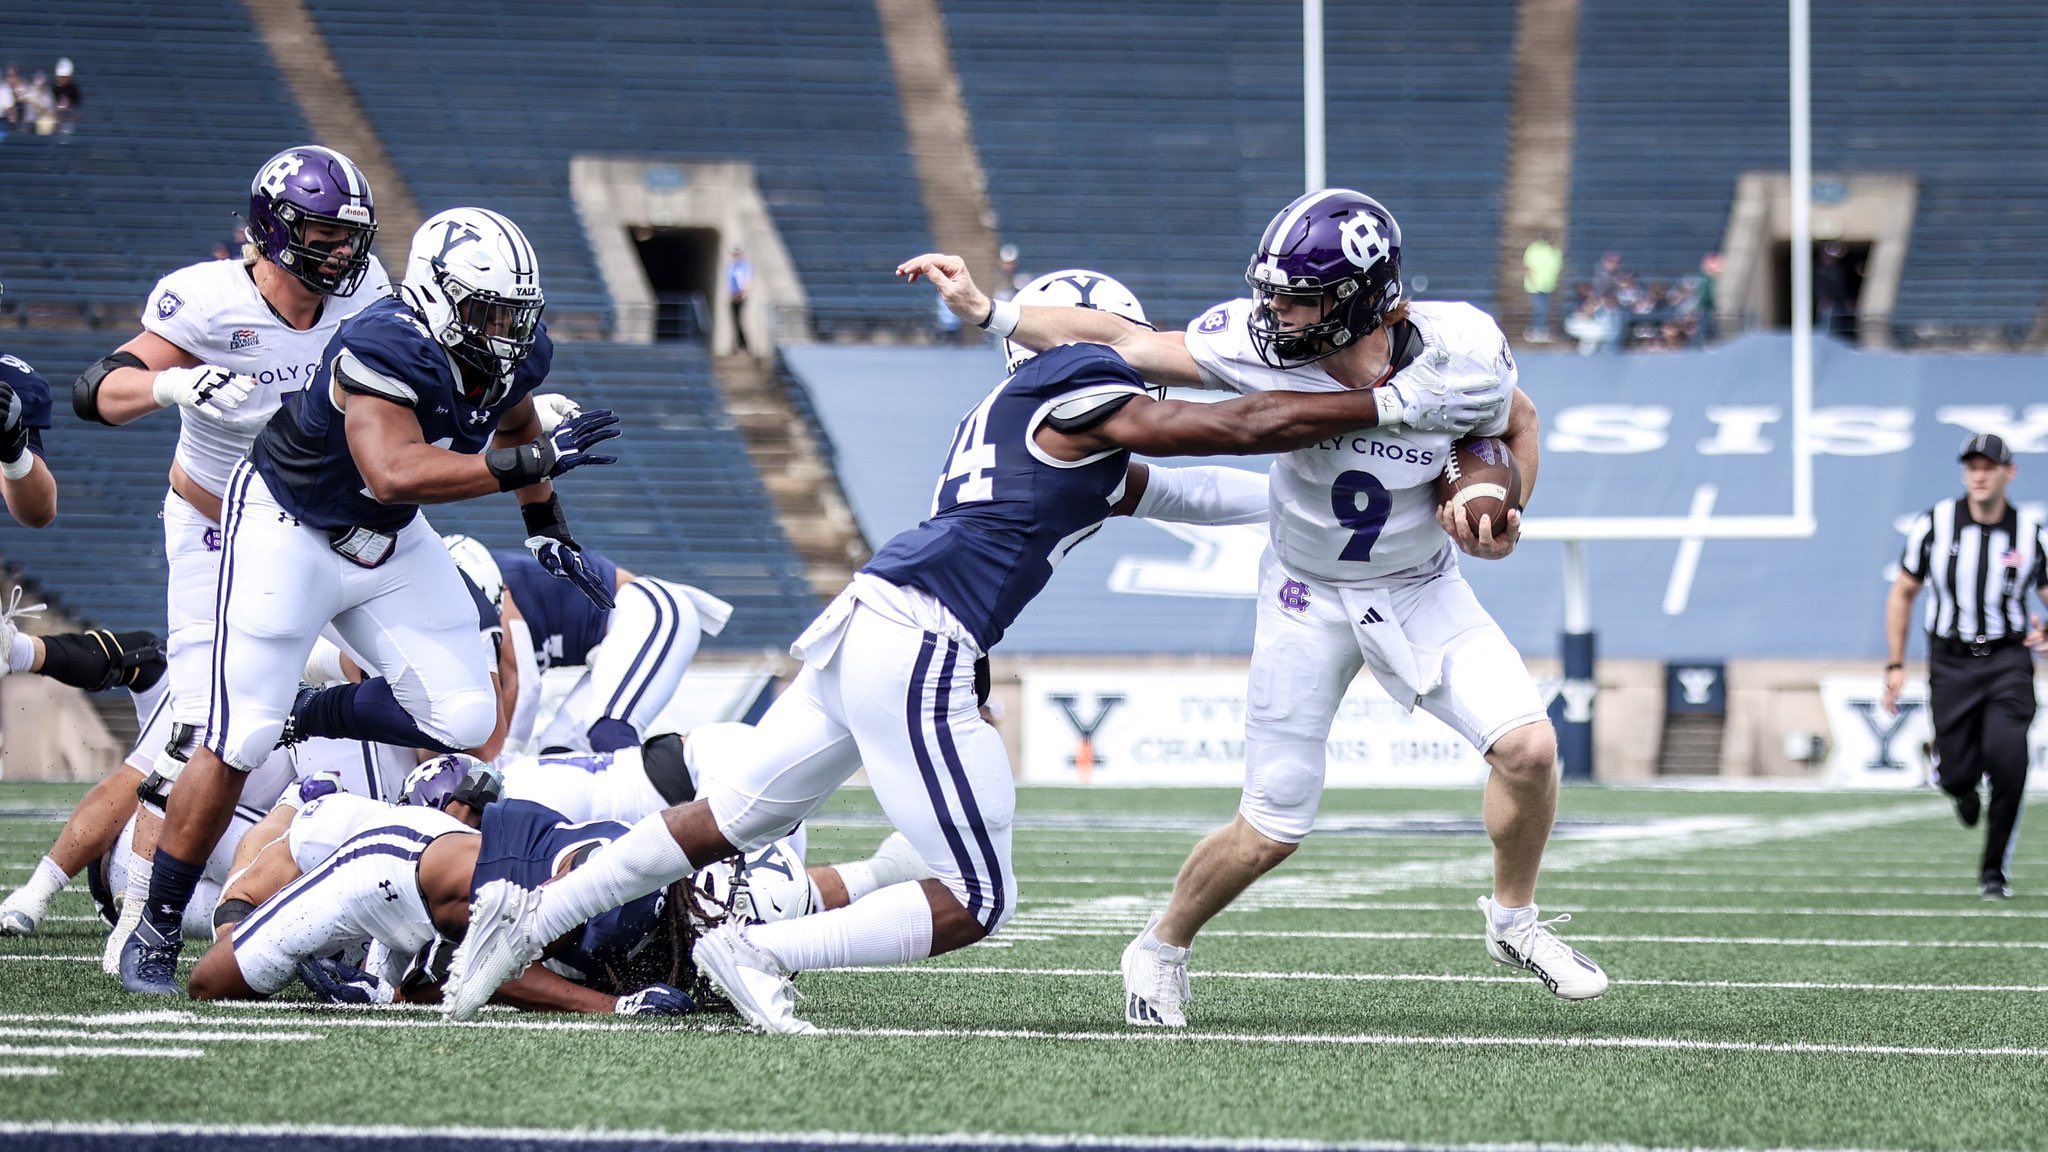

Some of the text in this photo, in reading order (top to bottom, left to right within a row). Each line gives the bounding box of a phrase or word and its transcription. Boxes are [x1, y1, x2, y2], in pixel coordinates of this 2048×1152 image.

[431, 220, 482, 269] Y
[516, 287, 536, 296] YALE
[1054, 275, 1106, 310] Y
[1351, 437, 1434, 466] CROSS
[1331, 469, 1393, 563] 9
[1046, 692, 1127, 766] Y
[1847, 700, 1927, 769] Y
